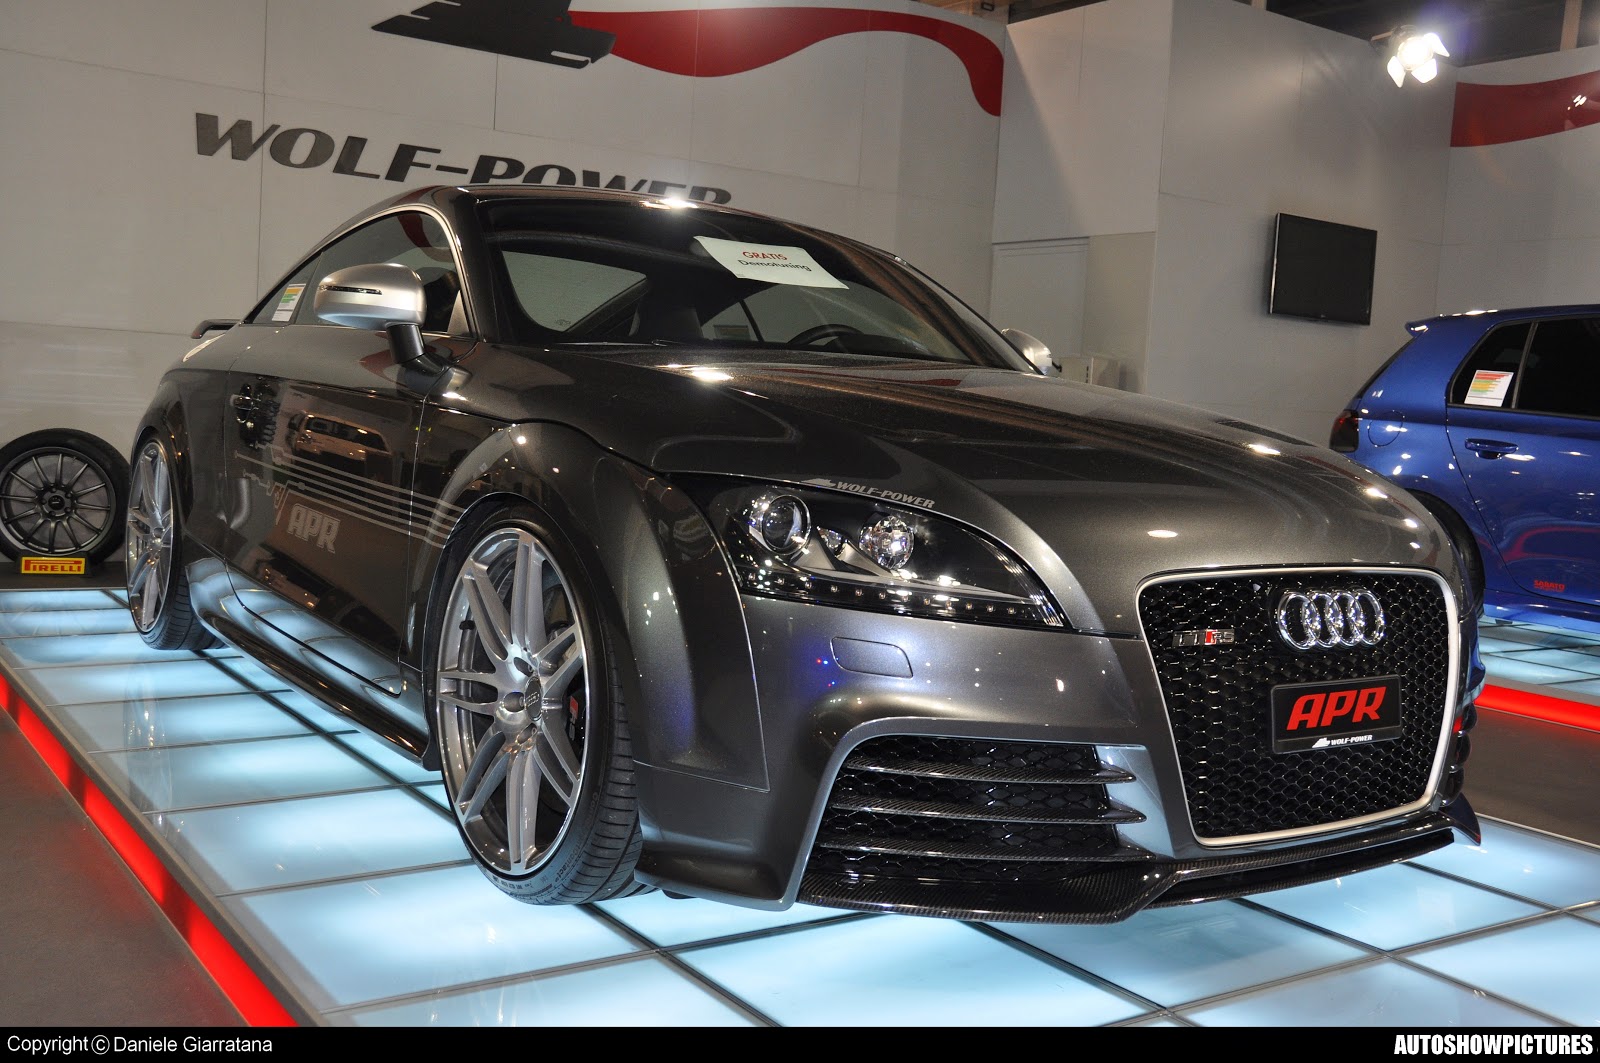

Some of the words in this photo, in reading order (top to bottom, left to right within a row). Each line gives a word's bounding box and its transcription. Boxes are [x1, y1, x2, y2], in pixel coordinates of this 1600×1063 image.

[742, 251, 788, 261] GRATIS
[738, 259, 812, 272] Demotuning
[836, 481, 935, 508] WOLF-POWER
[287, 503, 341, 554] APR
[24, 560, 82, 572] PIRELLI
[1286, 686, 1387, 731] APR
[1331, 734, 1373, 746] WOLF-POWER
